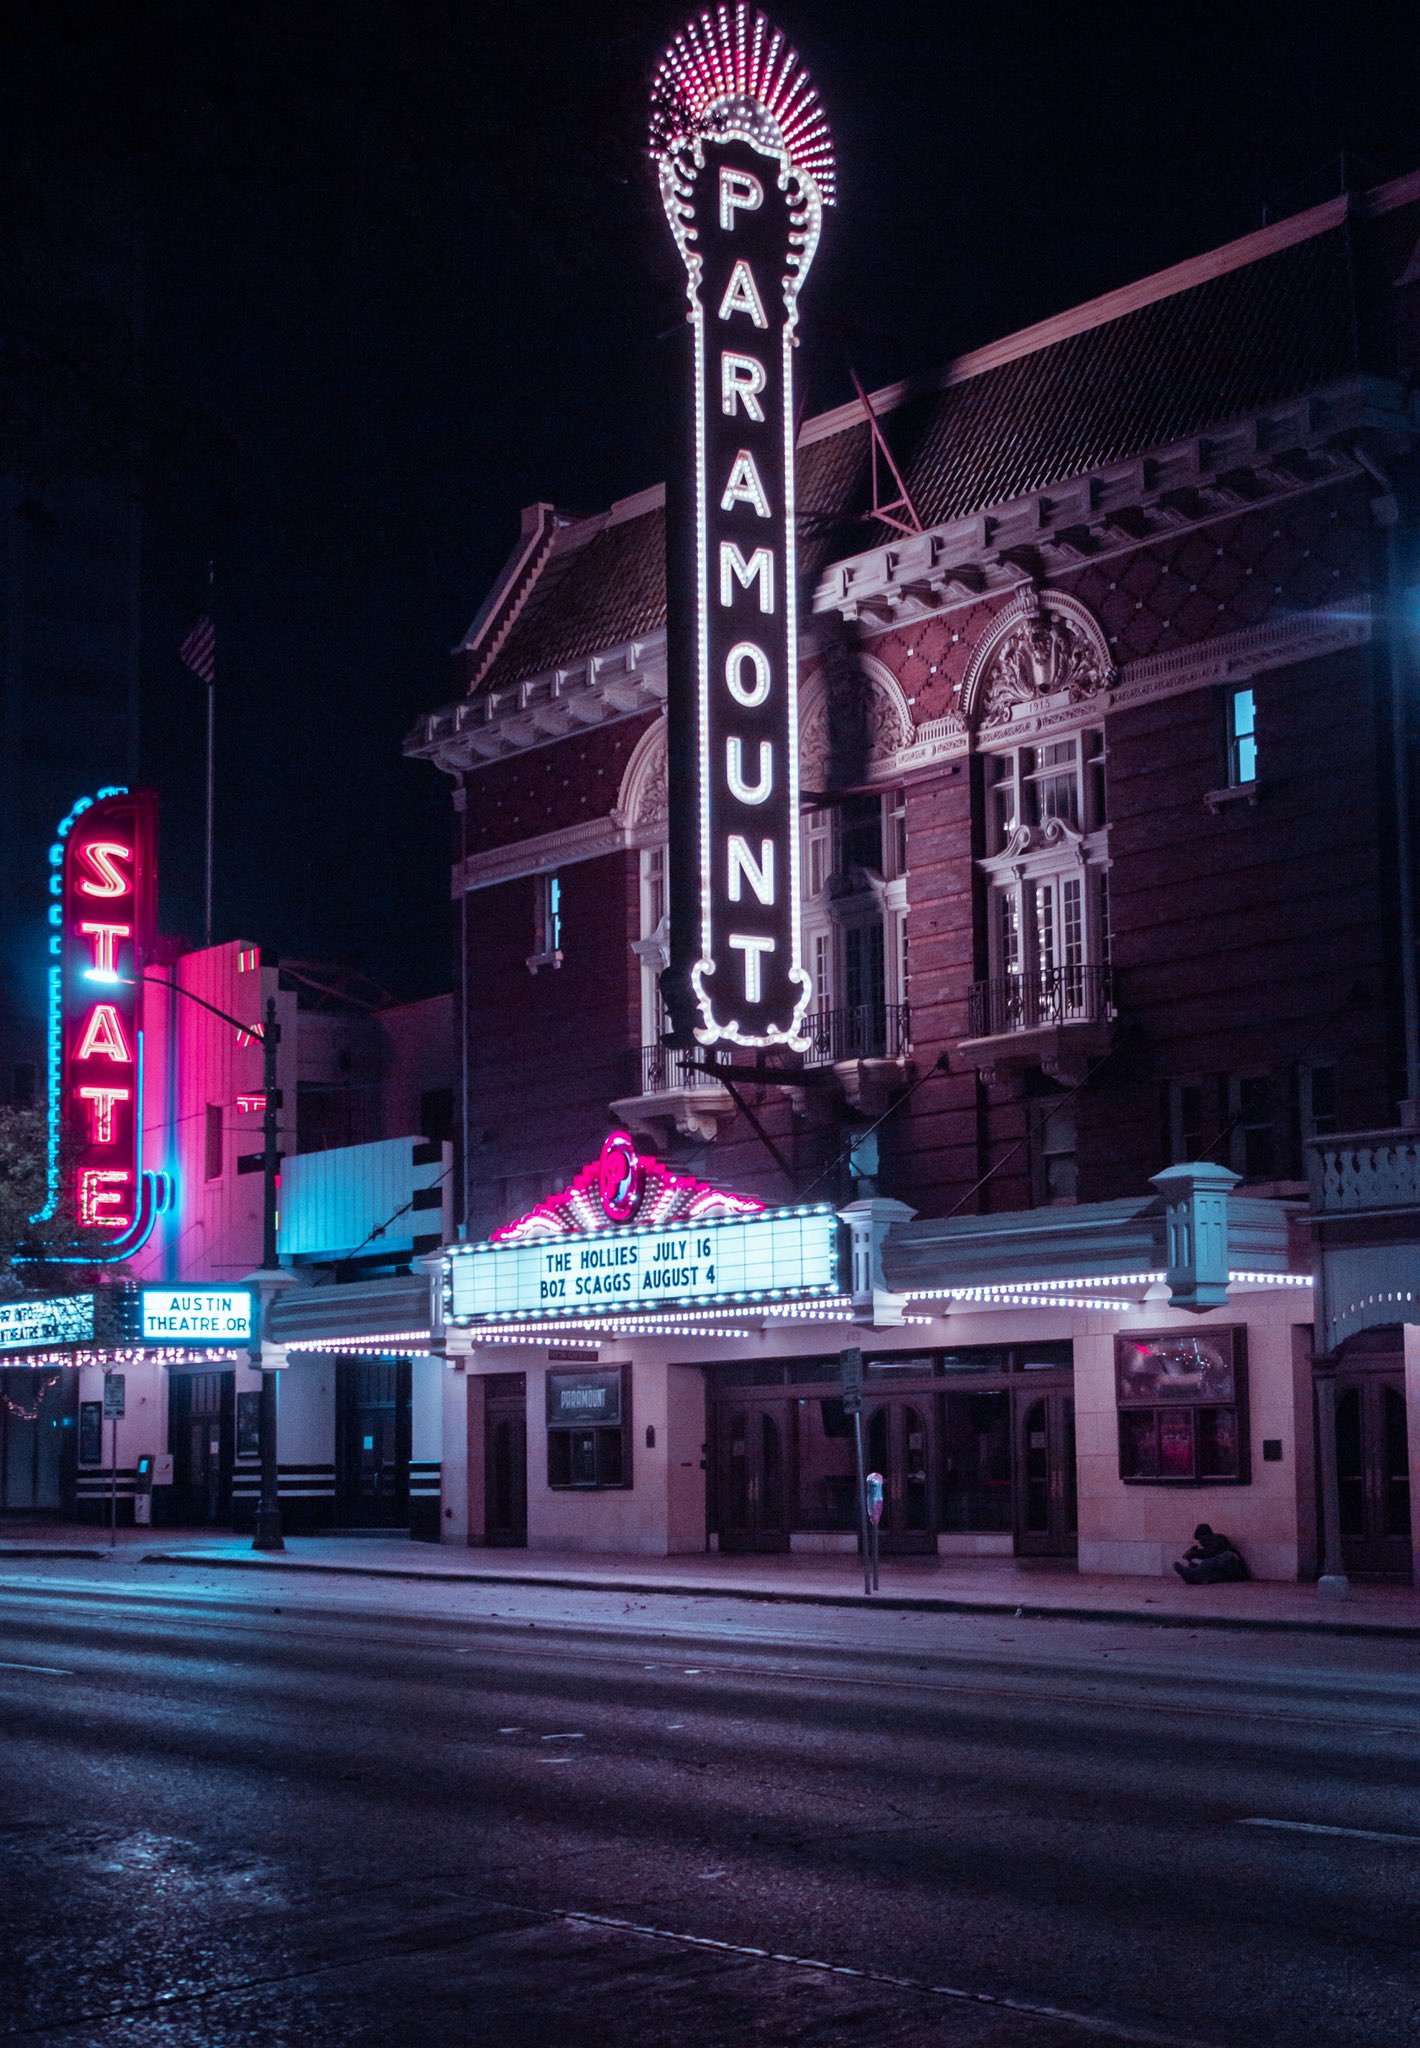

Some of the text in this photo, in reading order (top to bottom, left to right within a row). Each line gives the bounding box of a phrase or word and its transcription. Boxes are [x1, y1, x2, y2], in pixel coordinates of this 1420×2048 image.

[718, 166, 776, 1004] PARAMOUNT
[1029, 699, 1051, 713] 1915
[77, 840, 133, 1228] STATE
[546, 1238, 711, 1273] THE HOLLIES JULY 16
[540, 1264, 716, 1299] BOZ SCAGGS AUGUST 4
[169, 1296, 233, 1311] AUSTIN
[147, 1316, 251, 1331] THEATRE.OR
